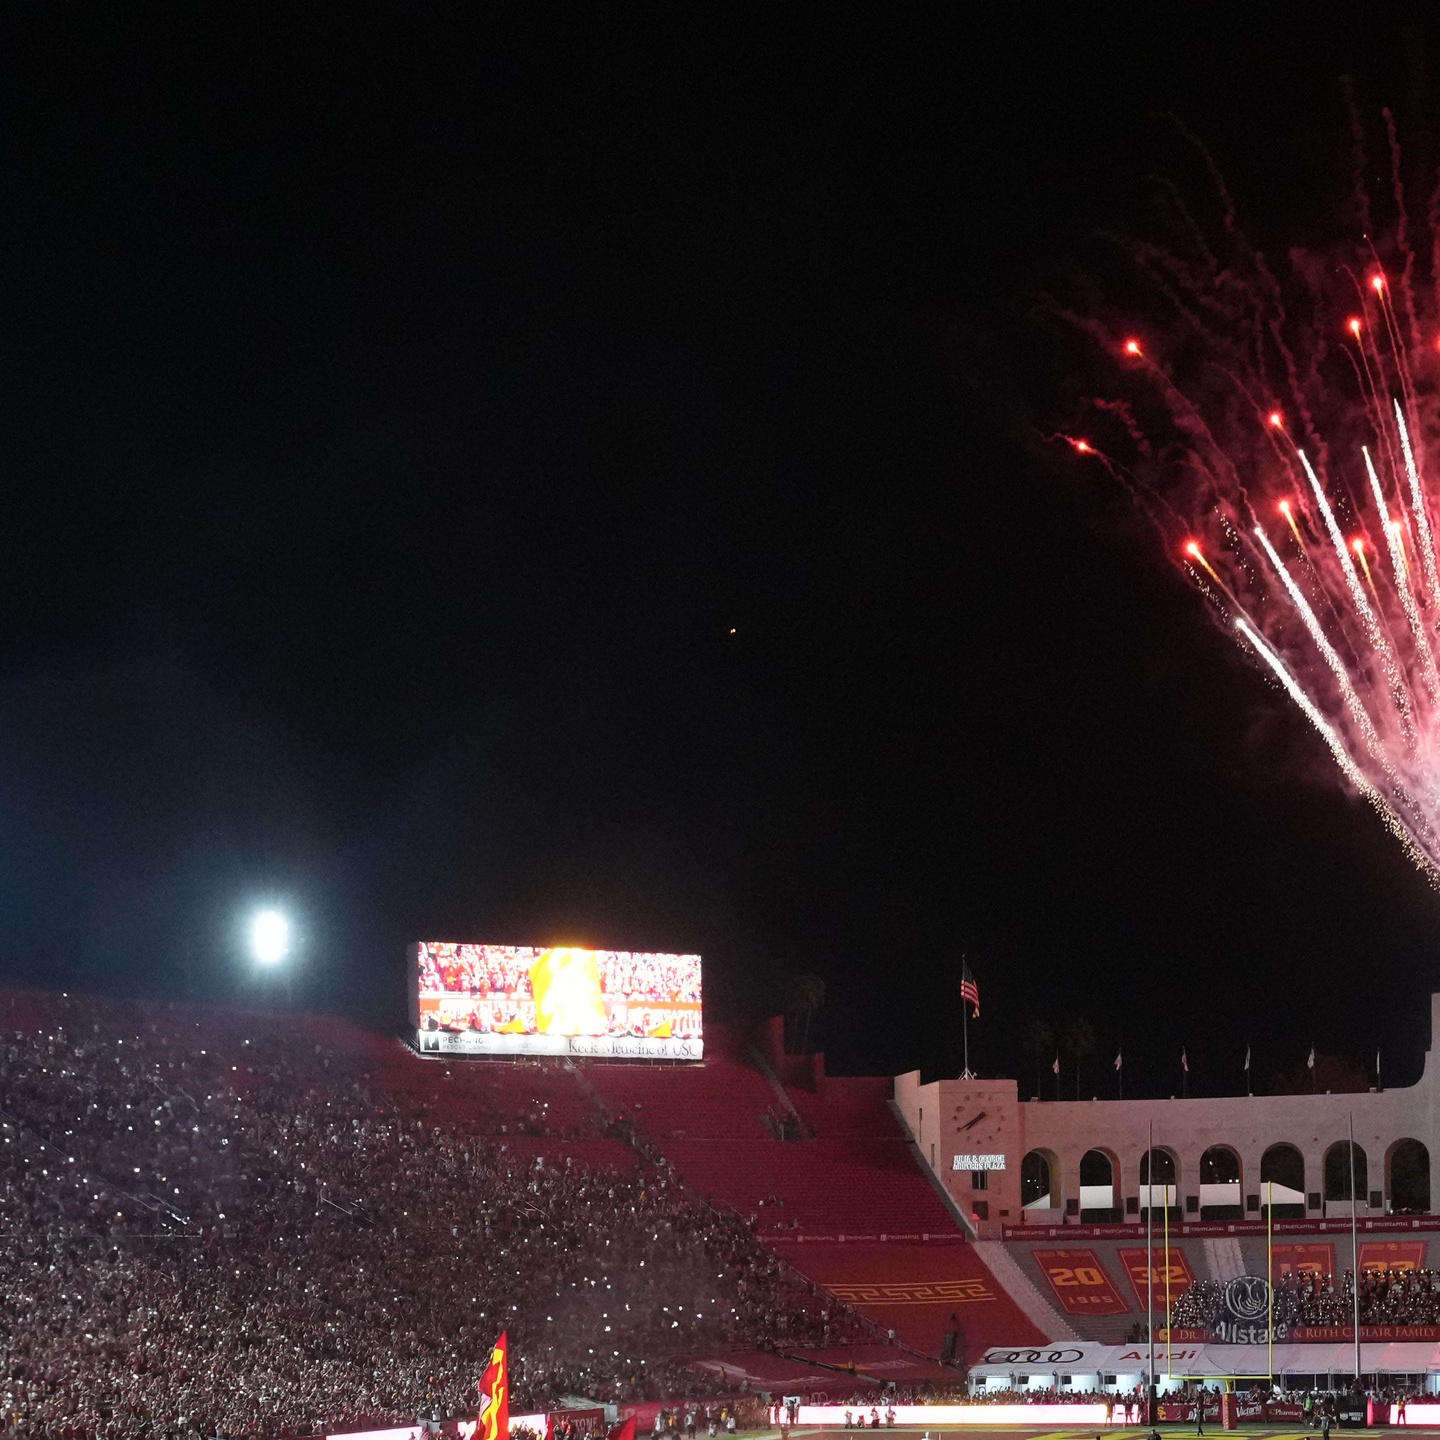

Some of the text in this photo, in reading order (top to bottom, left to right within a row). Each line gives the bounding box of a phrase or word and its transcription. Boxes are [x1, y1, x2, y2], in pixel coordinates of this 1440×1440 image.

[568, 1039, 599, 1054] Keck
[601, 1041, 653, 1056] Medicine
[672, 1043, 699, 1057] USC
[1049, 1267, 1104, 1286] 20
[1131, 1266, 1190, 1284] 32
[1069, 1296, 1114, 1304] 1965
[1180, 1330, 1198, 1339] DR.
[1305, 1328, 1339, 1338] RUTH
[1359, 1327, 1391, 1338] BLAIR
[1396, 1327, 1435, 1337] FAMILY
[1213, 1321, 1288, 1344] Allstate
[1118, 1350, 1196, 1361] Audi
[1236, 1404, 1262, 1418] Victoria
